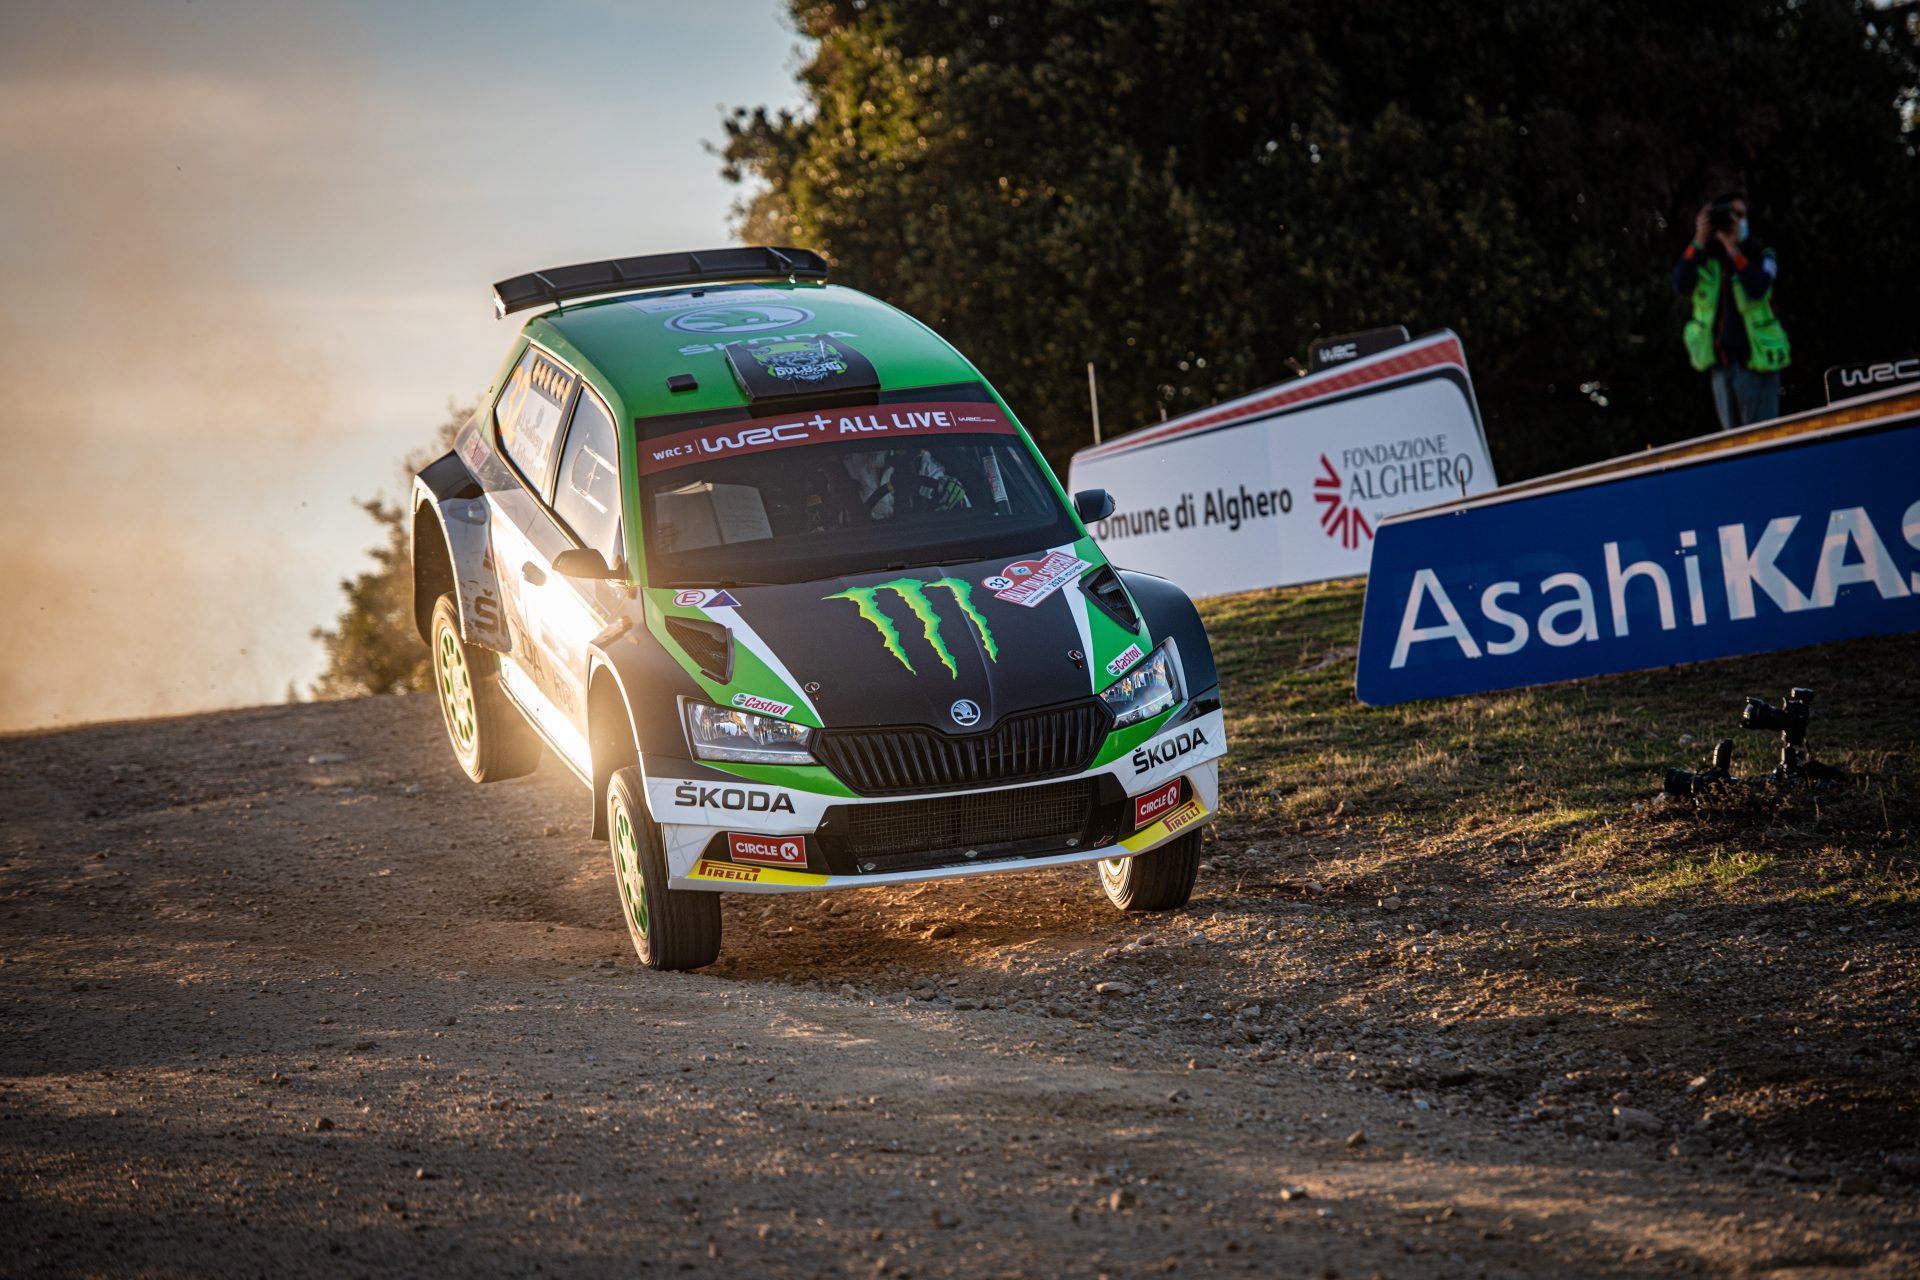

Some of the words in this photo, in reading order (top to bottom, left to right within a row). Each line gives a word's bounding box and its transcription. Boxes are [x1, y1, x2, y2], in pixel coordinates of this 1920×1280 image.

[1841, 358, 1920, 386] WRC
[652, 446, 682, 461] WRC
[684, 444, 693, 454] 3
[839, 414, 888, 434] ALL
[895, 411, 951, 428] LIVE
[1342, 434, 1448, 469] FONDAZIONE
[1348, 453, 1473, 502] ALGHERO
[1093, 507, 1170, 542] omune
[1175, 493, 1196, 529] di
[1204, 484, 1293, 532] Alghero
[989, 577, 1011, 589] 32
[1115, 645, 1142, 670] Castrol
[744, 697, 788, 715] Castrol
[1132, 727, 1209, 775] ŠKODA
[675, 781, 795, 814] ŠKODA
[1140, 794, 1167, 815] CIRCLE
[1167, 787, 1177, 805] K
[1162, 801, 1201, 832] PIRELLI
[735, 842, 778, 856] CIRCLE
[782, 843, 798, 860] K
[698, 861, 761, 881] PIRELLI
